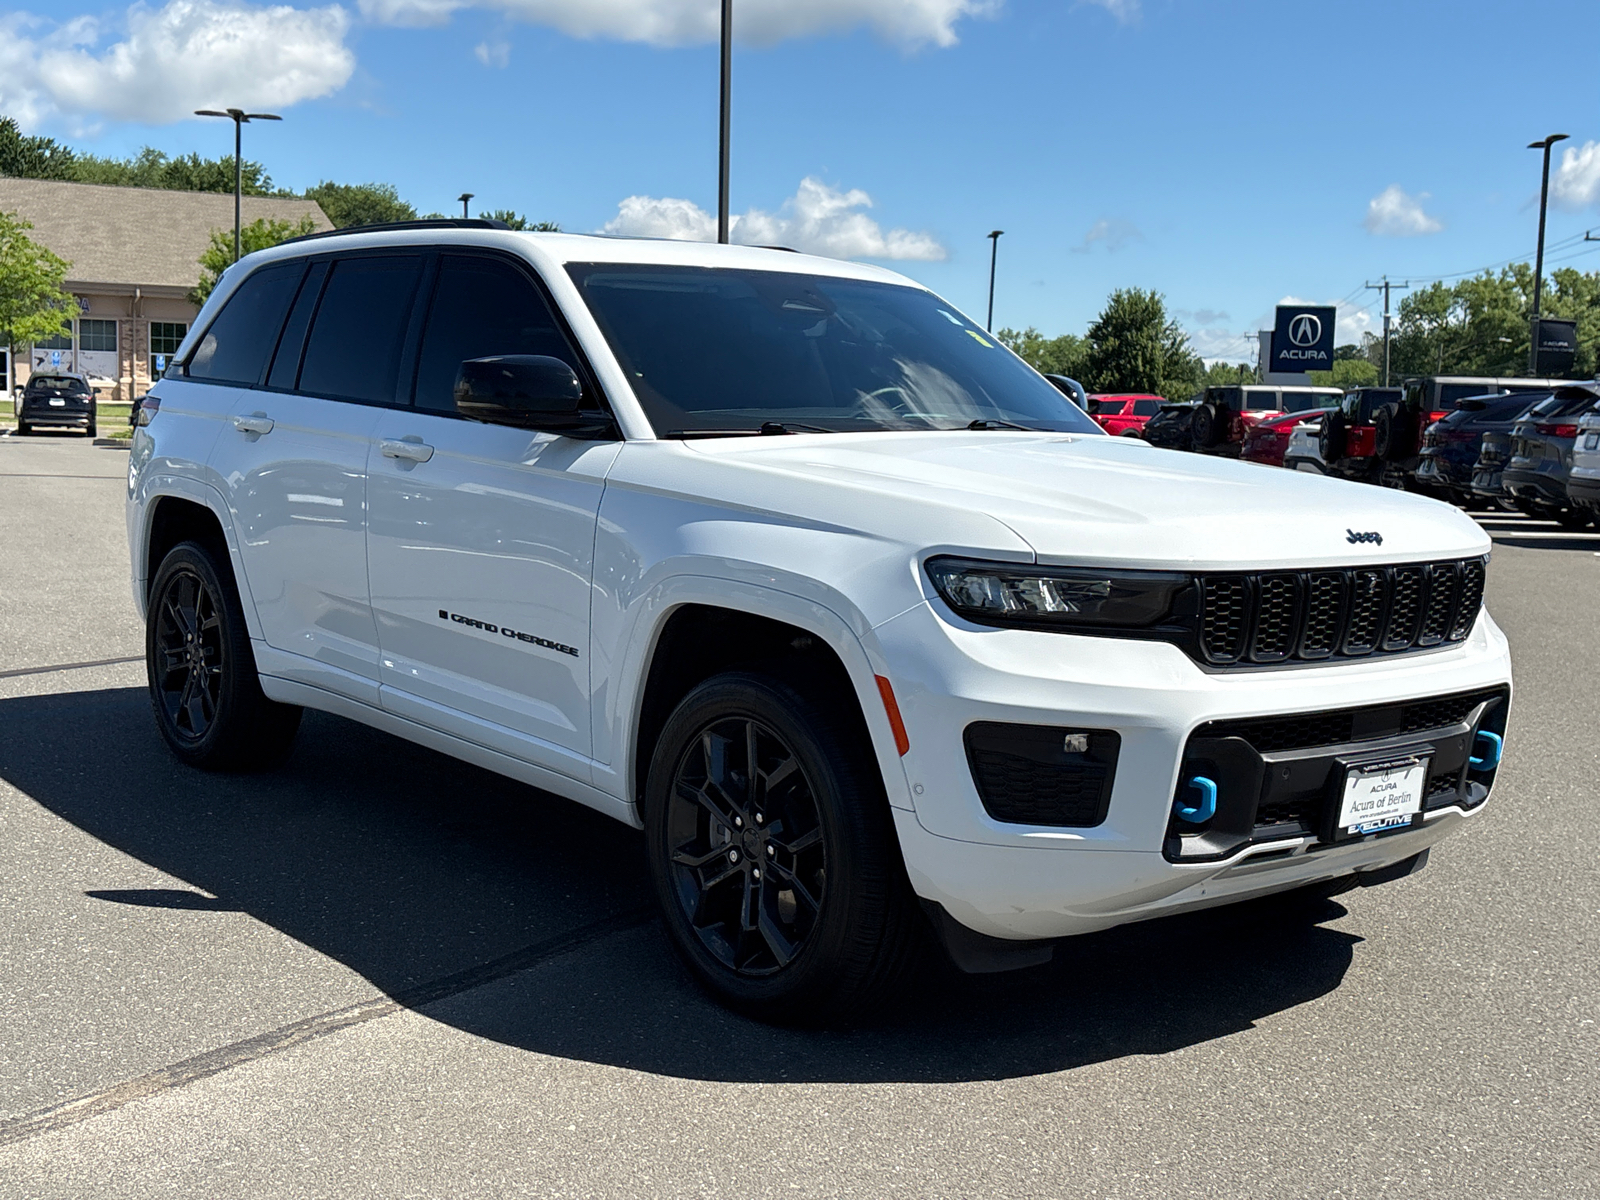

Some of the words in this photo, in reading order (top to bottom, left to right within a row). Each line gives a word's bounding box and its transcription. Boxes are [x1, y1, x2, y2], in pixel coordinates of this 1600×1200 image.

[1279, 349, 1328, 360] ACURA
[1345, 528, 1383, 546] Jeep
[450, 613, 498, 633] GRAND
[501, 627, 579, 658] CHEROKEE
[1370, 782, 1397, 794] ACURA
[1350, 800, 1374, 813] Acura
[1376, 797, 1386, 808] of
[1388, 792, 1411, 806] Berlin
[1347, 814, 1413, 835] EXECUTIVE
